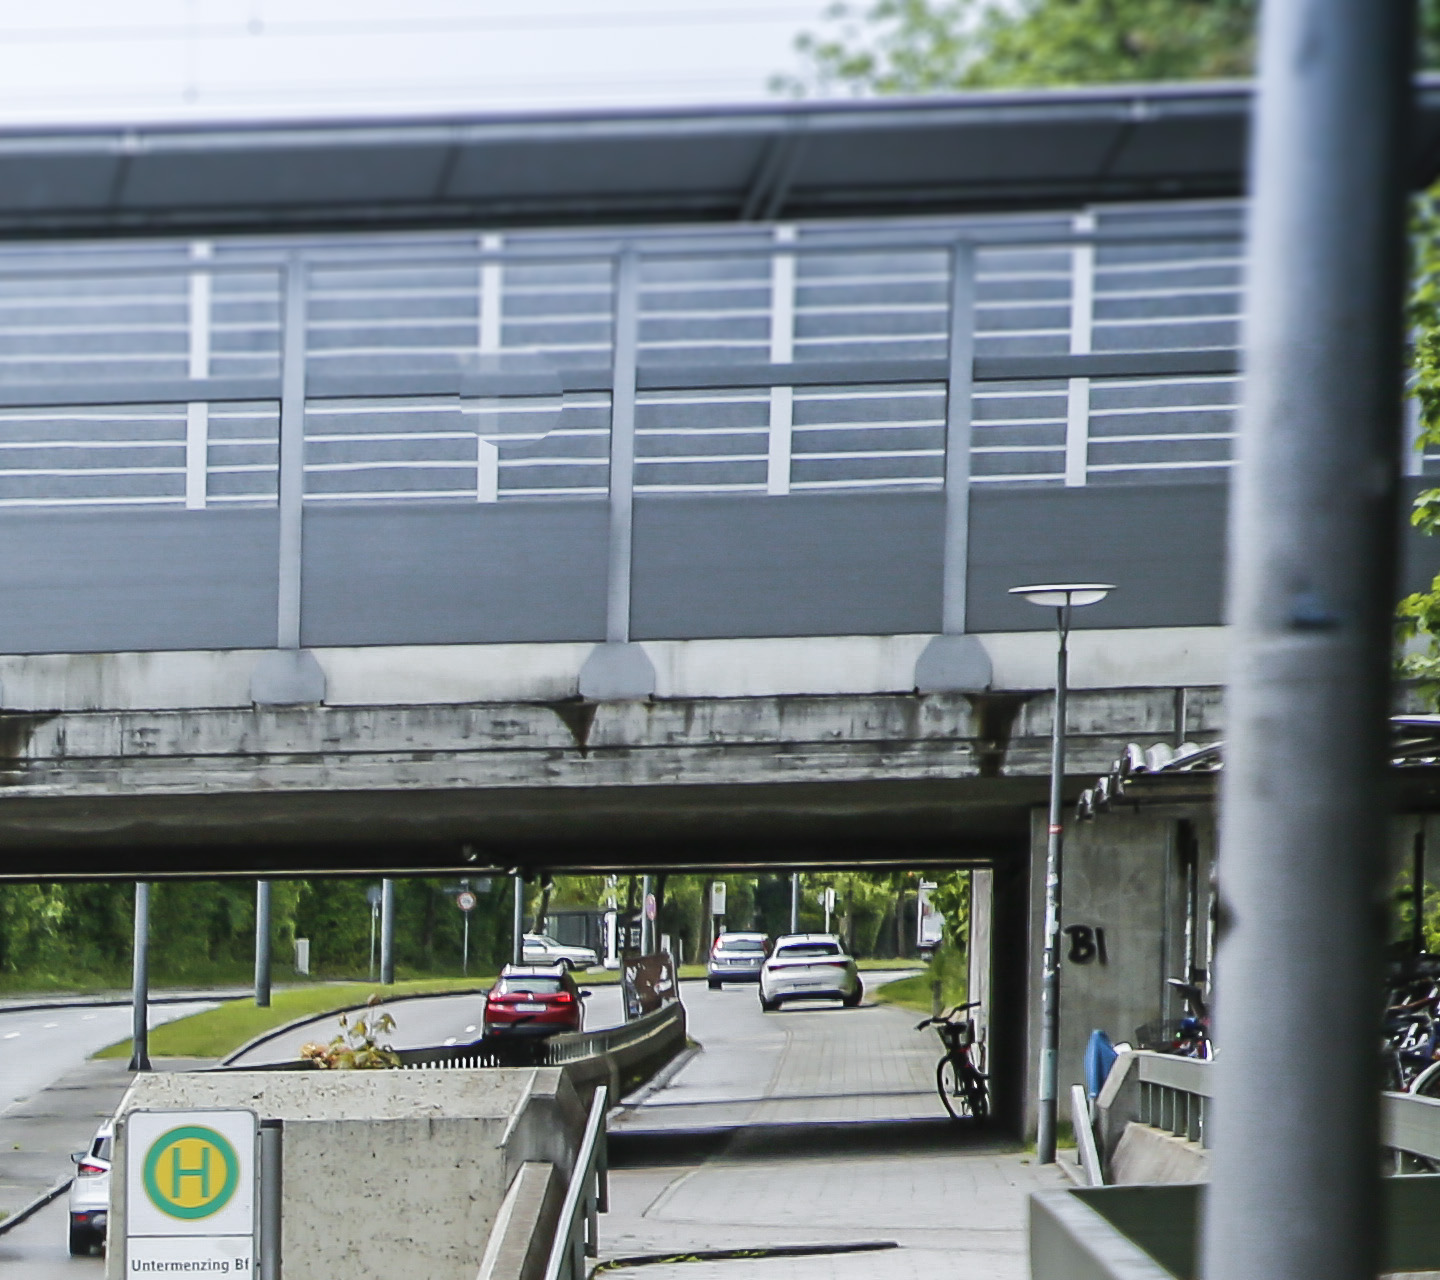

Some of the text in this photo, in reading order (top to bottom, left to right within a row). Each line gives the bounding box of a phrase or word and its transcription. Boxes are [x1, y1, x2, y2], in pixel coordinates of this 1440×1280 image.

[171, 1147, 210, 1198] H
[131, 1258, 250, 1274] Untermenzing Bf
